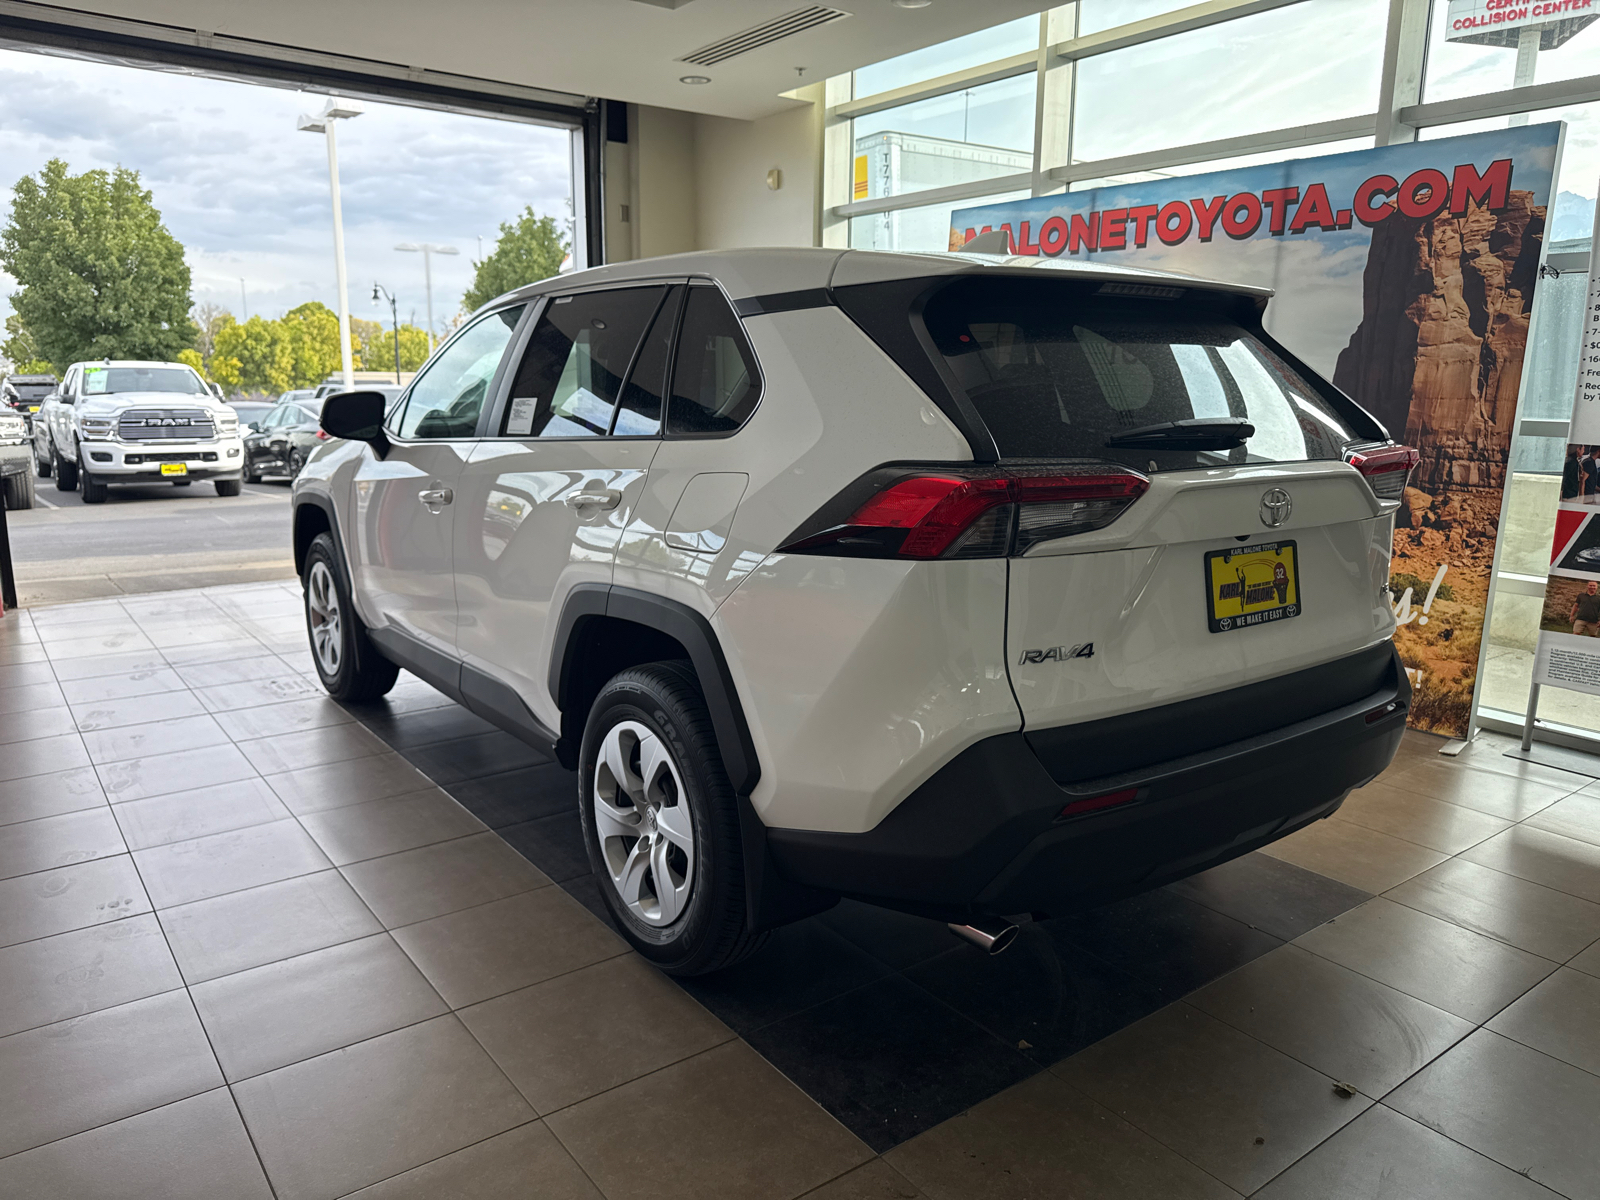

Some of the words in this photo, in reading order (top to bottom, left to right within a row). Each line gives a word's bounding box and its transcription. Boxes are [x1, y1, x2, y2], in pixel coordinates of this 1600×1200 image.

[1452, 7, 1528, 30] COLLISION
[1532, 0, 1592, 17] CENTER
[1275, 568, 1285, 579] 32
[1236, 616, 1246, 627] WE
[1246, 613, 1262, 625] MAKE
[1262, 612, 1269, 621] IT
[1269, 609, 1283, 620] EASY
[1018, 642, 1095, 665] RAV4
